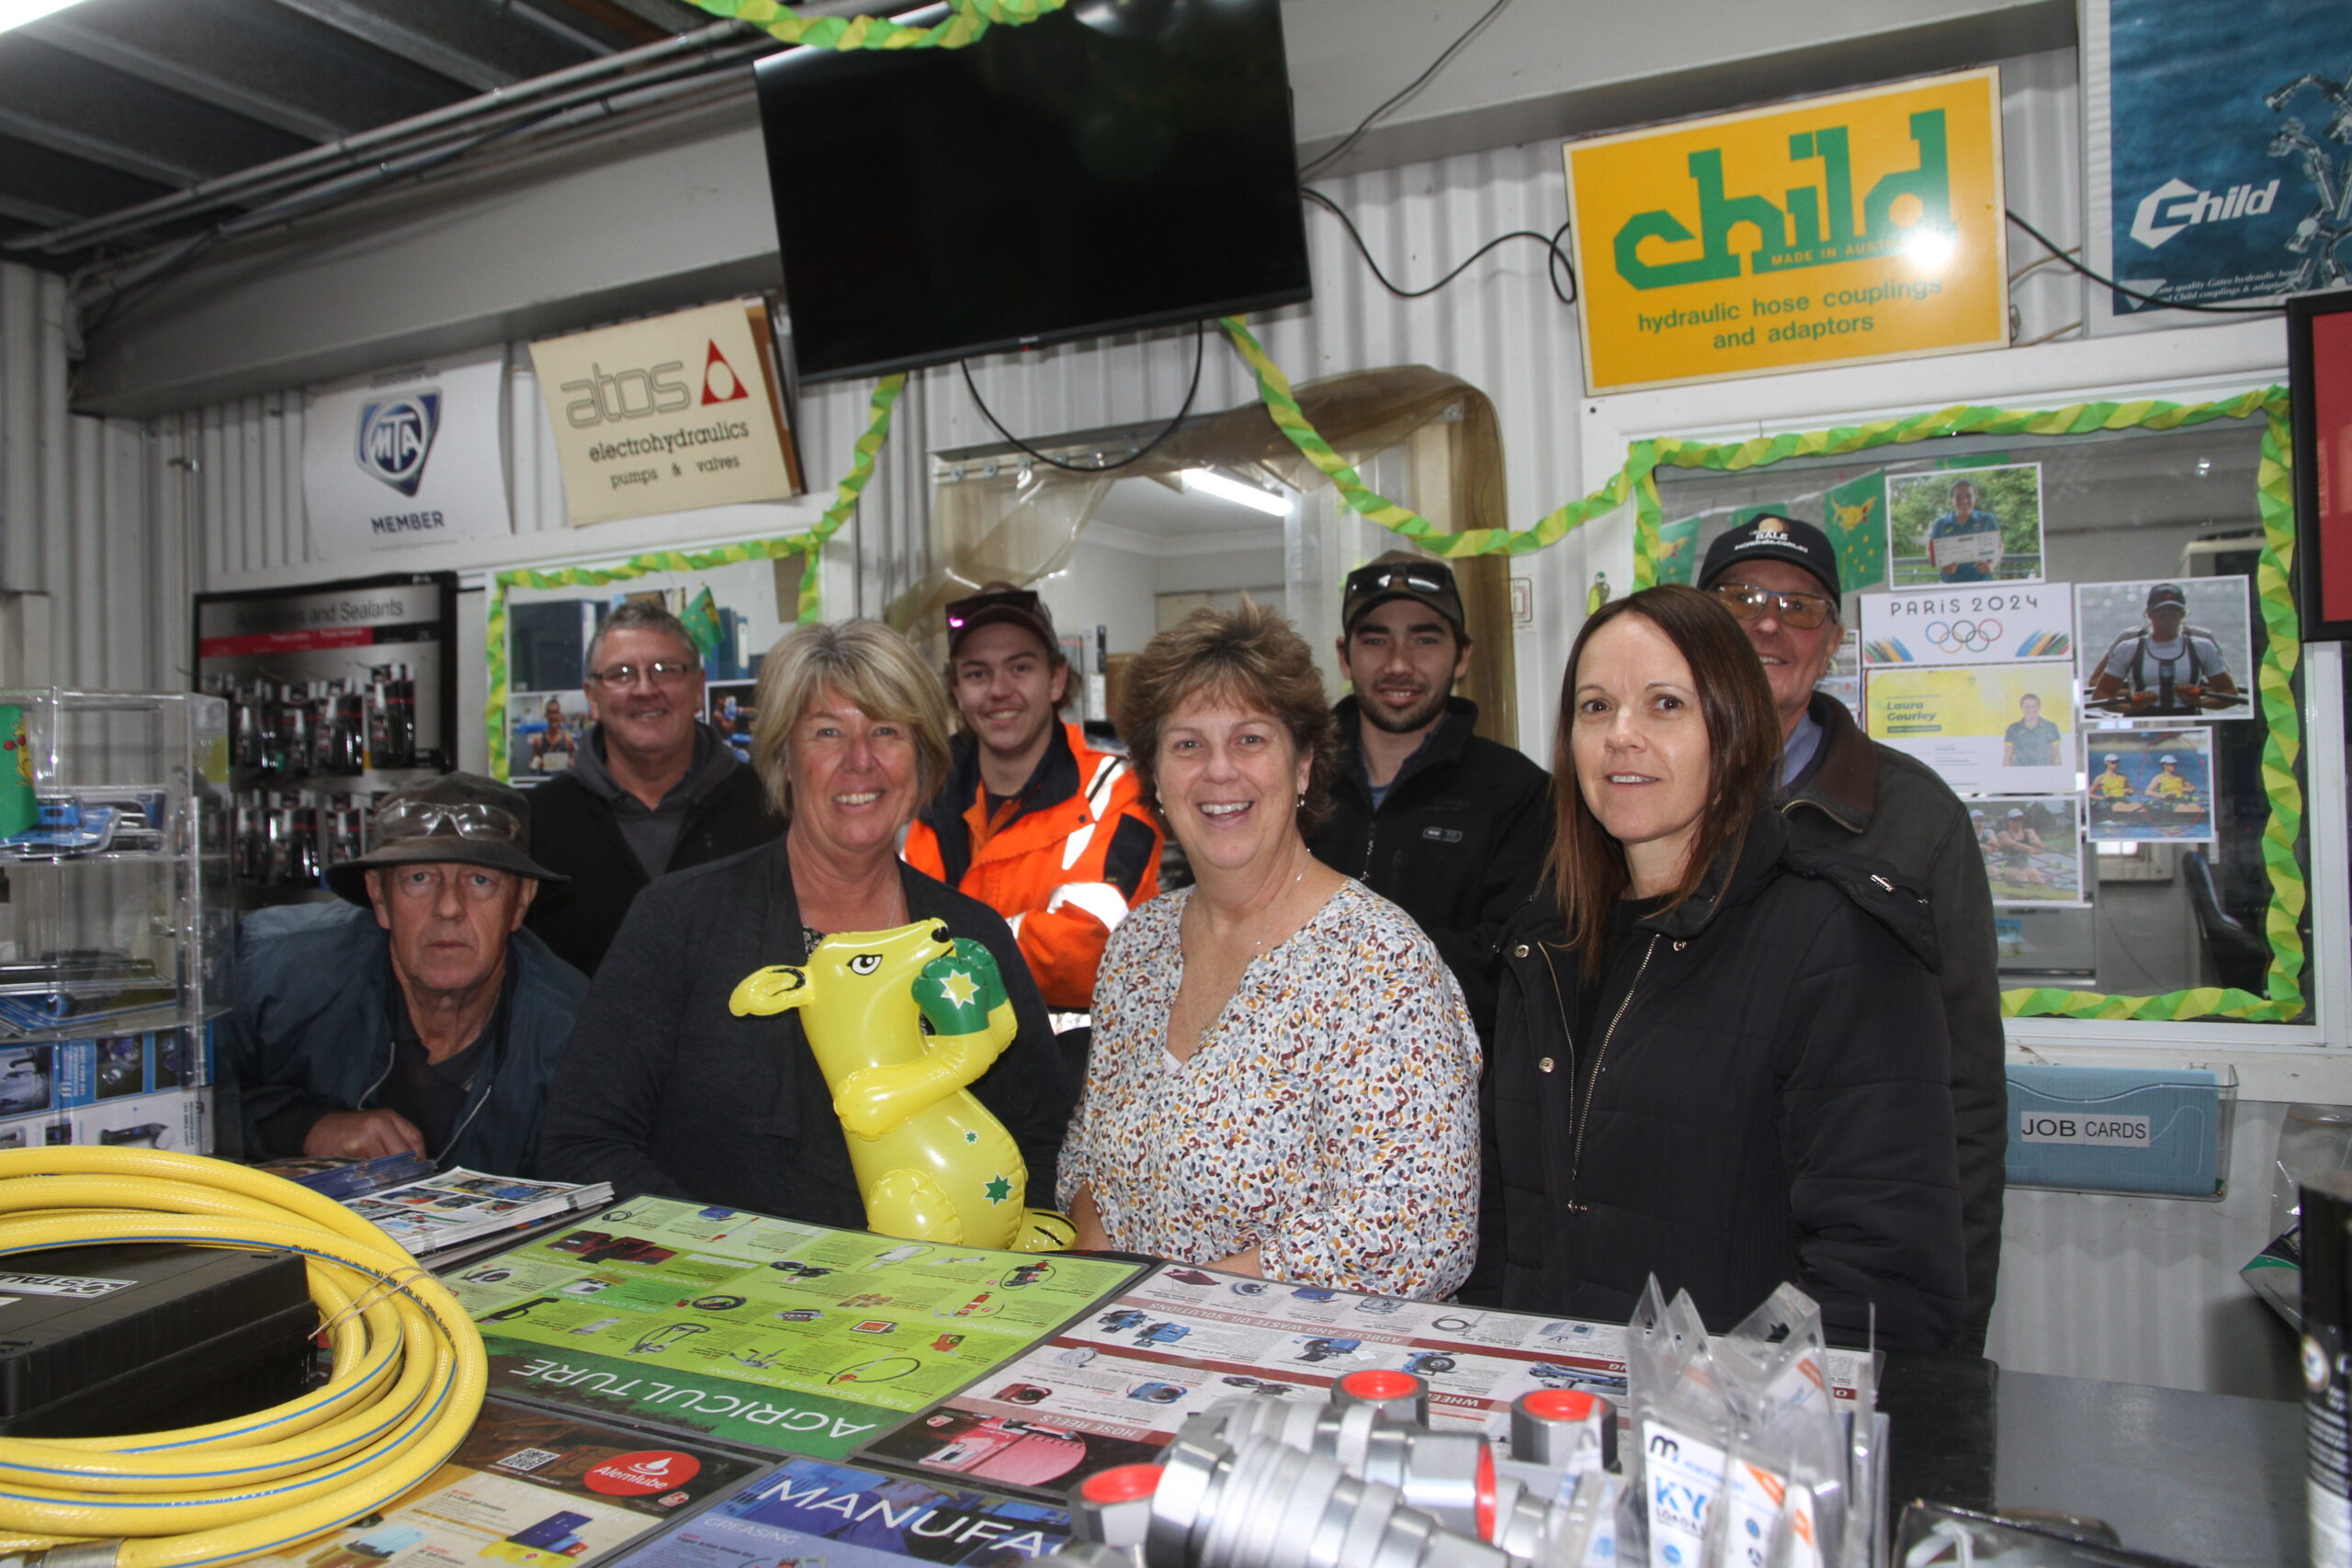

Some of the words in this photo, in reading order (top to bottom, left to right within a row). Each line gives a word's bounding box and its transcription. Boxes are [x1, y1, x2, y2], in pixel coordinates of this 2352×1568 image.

[1613, 108, 1958, 290] child
[2130, 177, 2280, 250] Child
[1771, 250, 1813, 265] MADE
[1821, 247, 1837, 259] IN
[1639, 301, 1740, 334] hydraulic
[1753, 293, 1809, 317] hose
[1824, 276, 1942, 310] couplings
[1713, 327, 1756, 350] and
[1768, 312, 1875, 344] adaptors
[560, 360, 691, 429] atos
[370, 412, 422, 471] MTA
[589, 422, 749, 463] electrohydraulics
[610, 468, 658, 490] pumps
[672, 462, 682, 477] &
[696, 456, 740, 473] valves
[370, 511, 446, 534] MEMBER
[309, 604, 335, 624] and
[339, 600, 403, 622] Sealants
[1972, 594, 2038, 613] 2024
[1886, 701, 1924, 711] Laura
[1887, 712, 1937, 722] Gourley
[2022, 1118, 2076, 1136] JOB
[2086, 1121, 2146, 1139] CARDS
[1148, 1303, 1226, 1322] SOLUTIONS
[1228, 1314, 1249, 1325] OIL
[1253, 1318, 1301, 1333] WASTE
[1308, 1326, 1337, 1337] AND
[1342, 1329, 1402, 1344] ADBLUE
[698, 1364, 778, 1383] METERING
[509, 1358, 877, 1439] AGRICULTURE
[784, 1380, 873, 1401] TRANSFER
[867, 1395, 916, 1409] FUEL
[1038, 1414, 1091, 1430] REELS
[1093, 1422, 1138, 1438] HOSE
[594, 1465, 669, 1490] Alemlube
[757, 1479, 1058, 1559] MANUFA
[703, 1517, 802, 1545] GREASING
